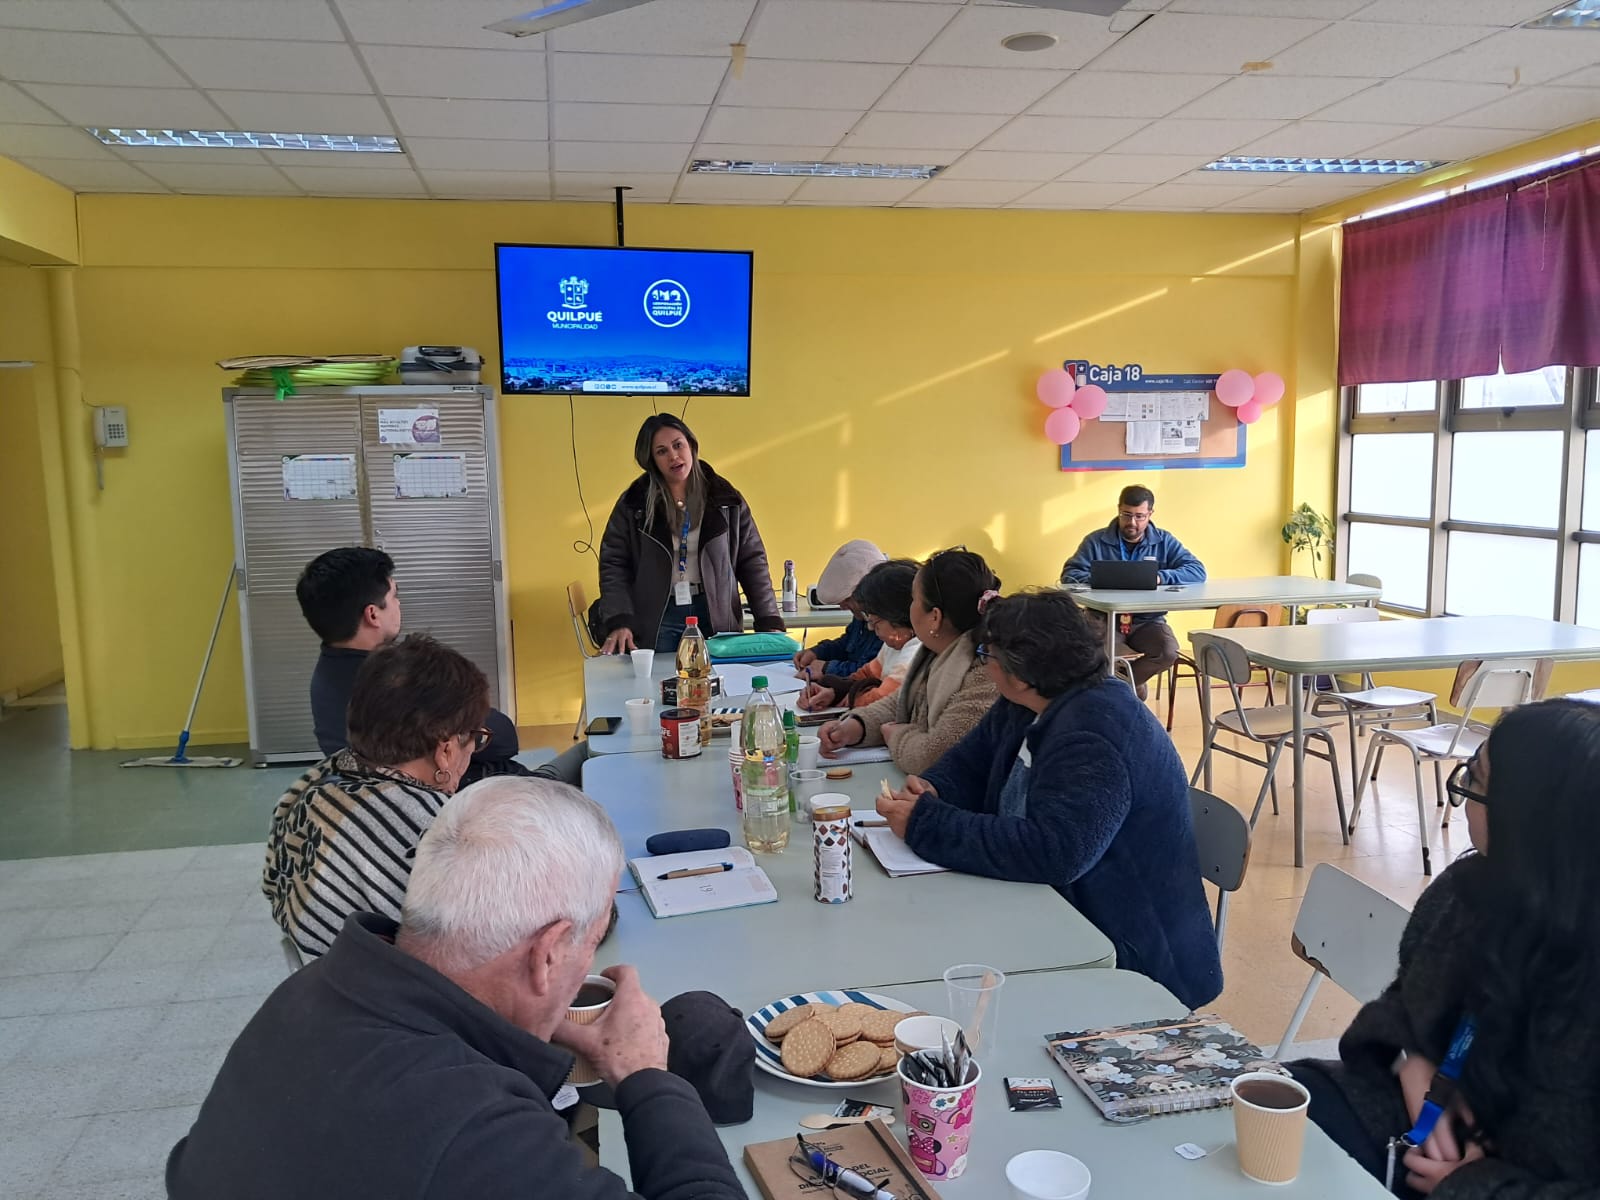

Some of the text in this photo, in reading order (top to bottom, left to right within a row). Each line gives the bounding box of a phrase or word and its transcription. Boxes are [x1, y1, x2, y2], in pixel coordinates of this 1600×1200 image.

[547, 311, 603, 322] QUILPUÉ
[1089, 366, 1141, 385] Caja 18
